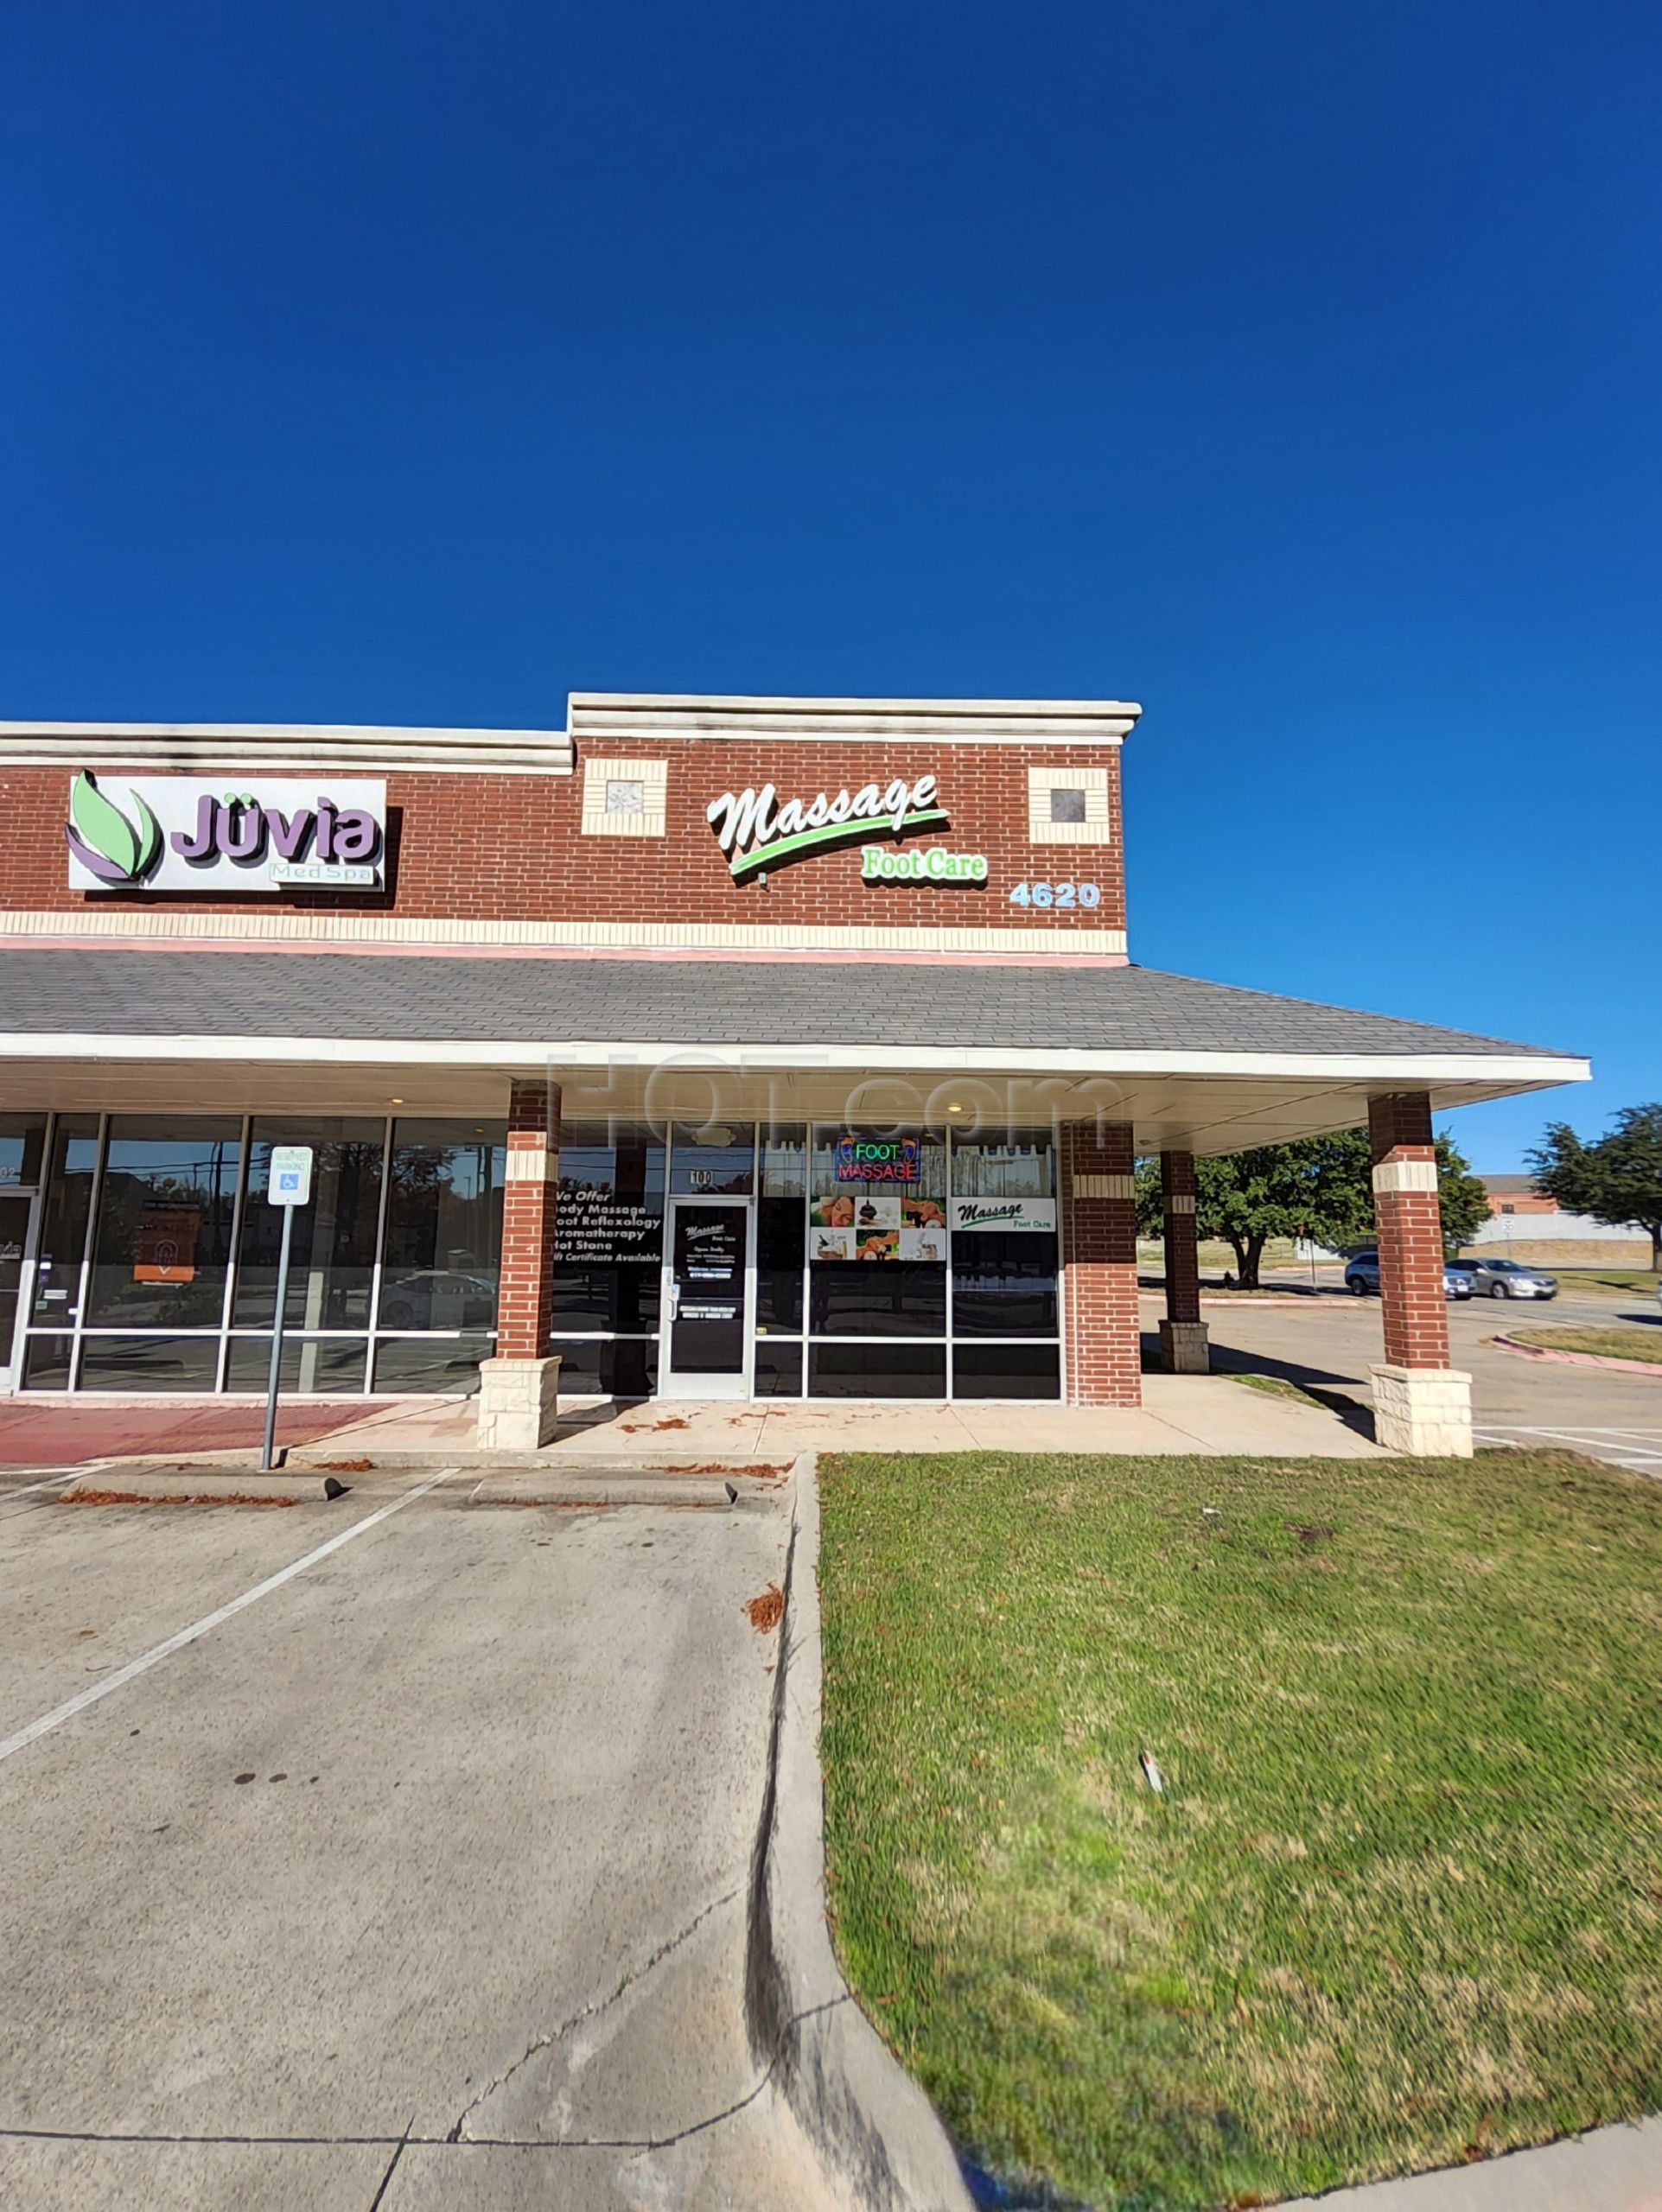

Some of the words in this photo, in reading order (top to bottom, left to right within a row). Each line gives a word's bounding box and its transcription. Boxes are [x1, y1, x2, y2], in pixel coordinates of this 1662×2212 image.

[707, 774, 938, 849] Massage
[863, 848, 921, 878] Foot
[924, 849, 986, 880] Care
[1009, 882, 1101, 908] 4620
[856, 1143, 900, 1160] FOOT
[691, 1170, 712, 1184] 100
[838, 1162, 917, 1180] MASSAGE
[576, 1191, 611, 1201] Offer
[556, 1203, 584, 1216] ody
[588, 1205, 646, 1217] Massage
[958, 1204, 1023, 1220] Massage
[556, 1217, 578, 1225] oot
[582, 1216, 661, 1230] Reflexology
[576, 1240, 613, 1250] Stone
